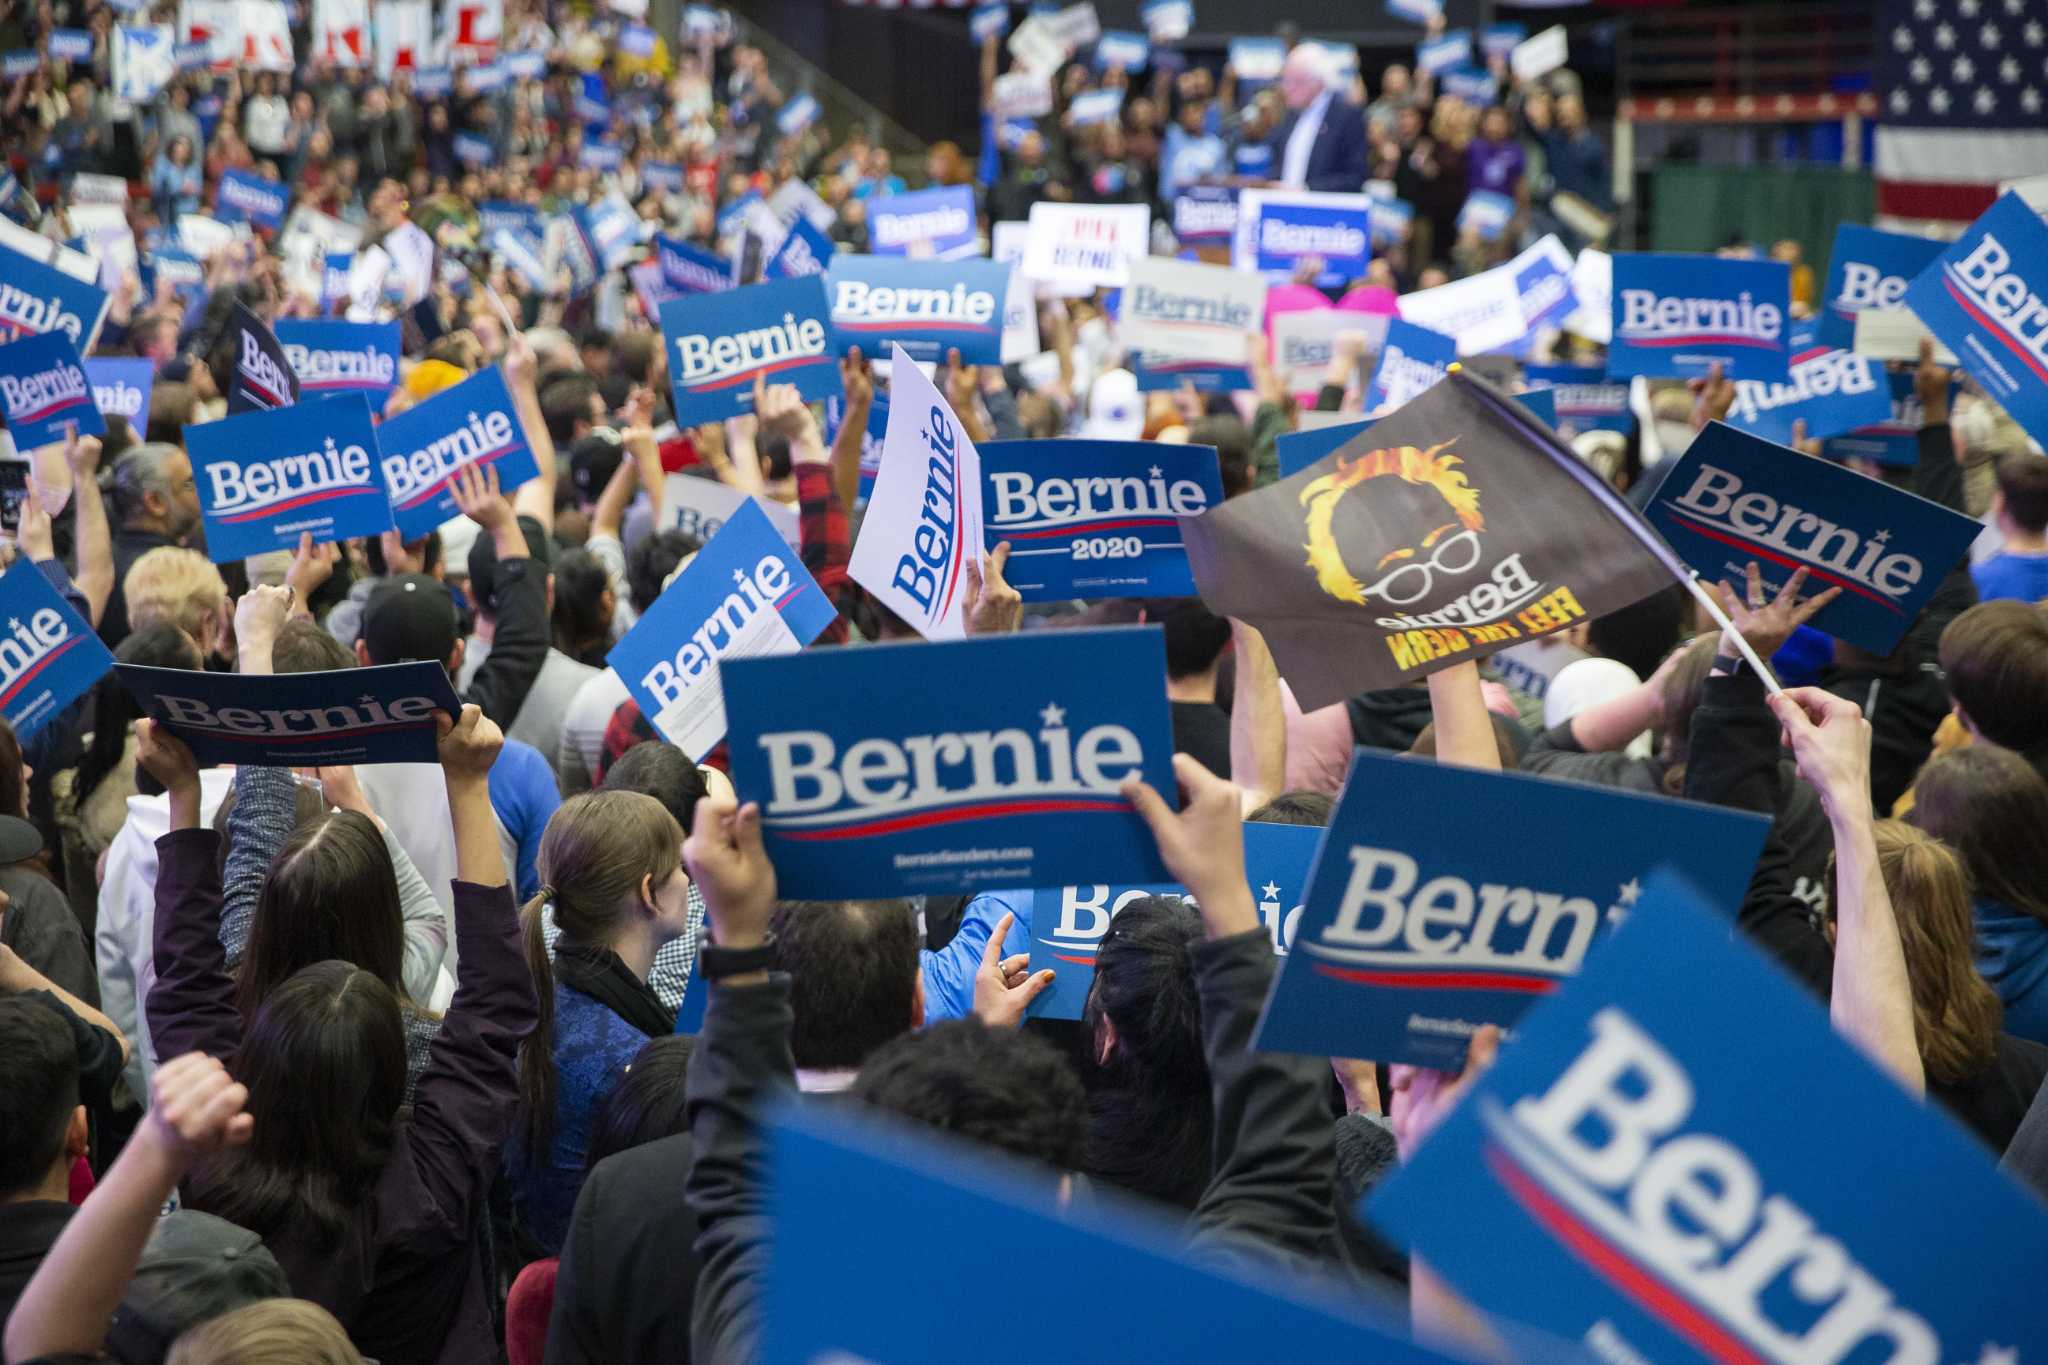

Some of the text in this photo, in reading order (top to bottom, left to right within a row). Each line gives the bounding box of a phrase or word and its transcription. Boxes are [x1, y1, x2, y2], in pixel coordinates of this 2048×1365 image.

[834, 281, 996, 325] Bernie
[1133, 284, 1252, 328] Bernie
[1621, 290, 1782, 341] Bernie
[283, 344, 394, 384] Bernie
[676, 312, 826, 380] Bernie
[0, 360, 87, 415] Bernie
[205, 436, 371, 508] Bernie
[382, 410, 514, 499] Bernie
[893, 405, 954, 615] Bernie
[989, 465, 1207, 523] Bernie
[1071, 536, 1144, 561] 2020
[1675, 464, 1923, 595] Bernie
[640, 553, 792, 711] Bernie
[154, 693, 438, 736] Bernie
[757, 702, 1145, 814] Bernie
[1321, 845, 1628, 976] Bern
